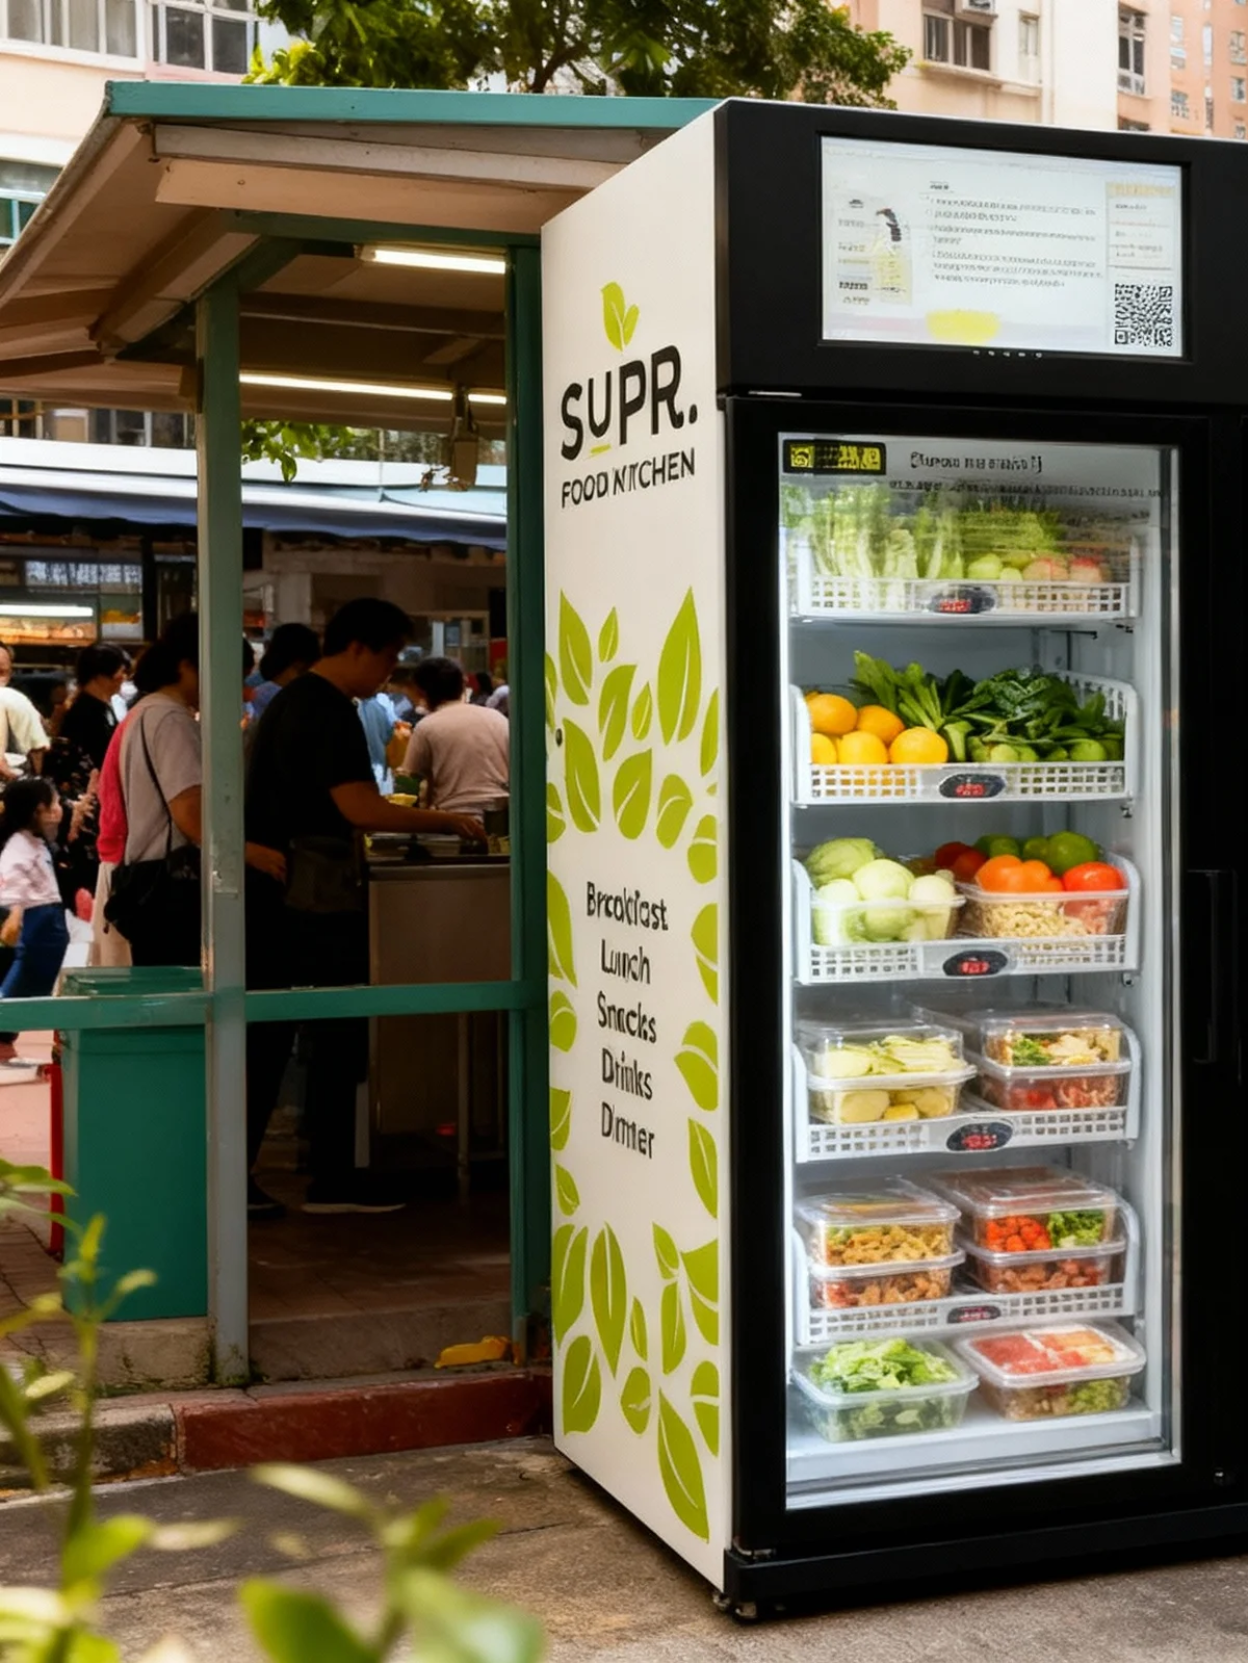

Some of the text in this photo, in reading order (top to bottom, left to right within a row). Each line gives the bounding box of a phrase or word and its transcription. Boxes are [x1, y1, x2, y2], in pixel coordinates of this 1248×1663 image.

[561, 345, 698, 460] SUPR.
[561, 471, 609, 508] FOOD
[597, 990, 657, 1043] Snacks
[602, 1048, 653, 1100] Drinks
